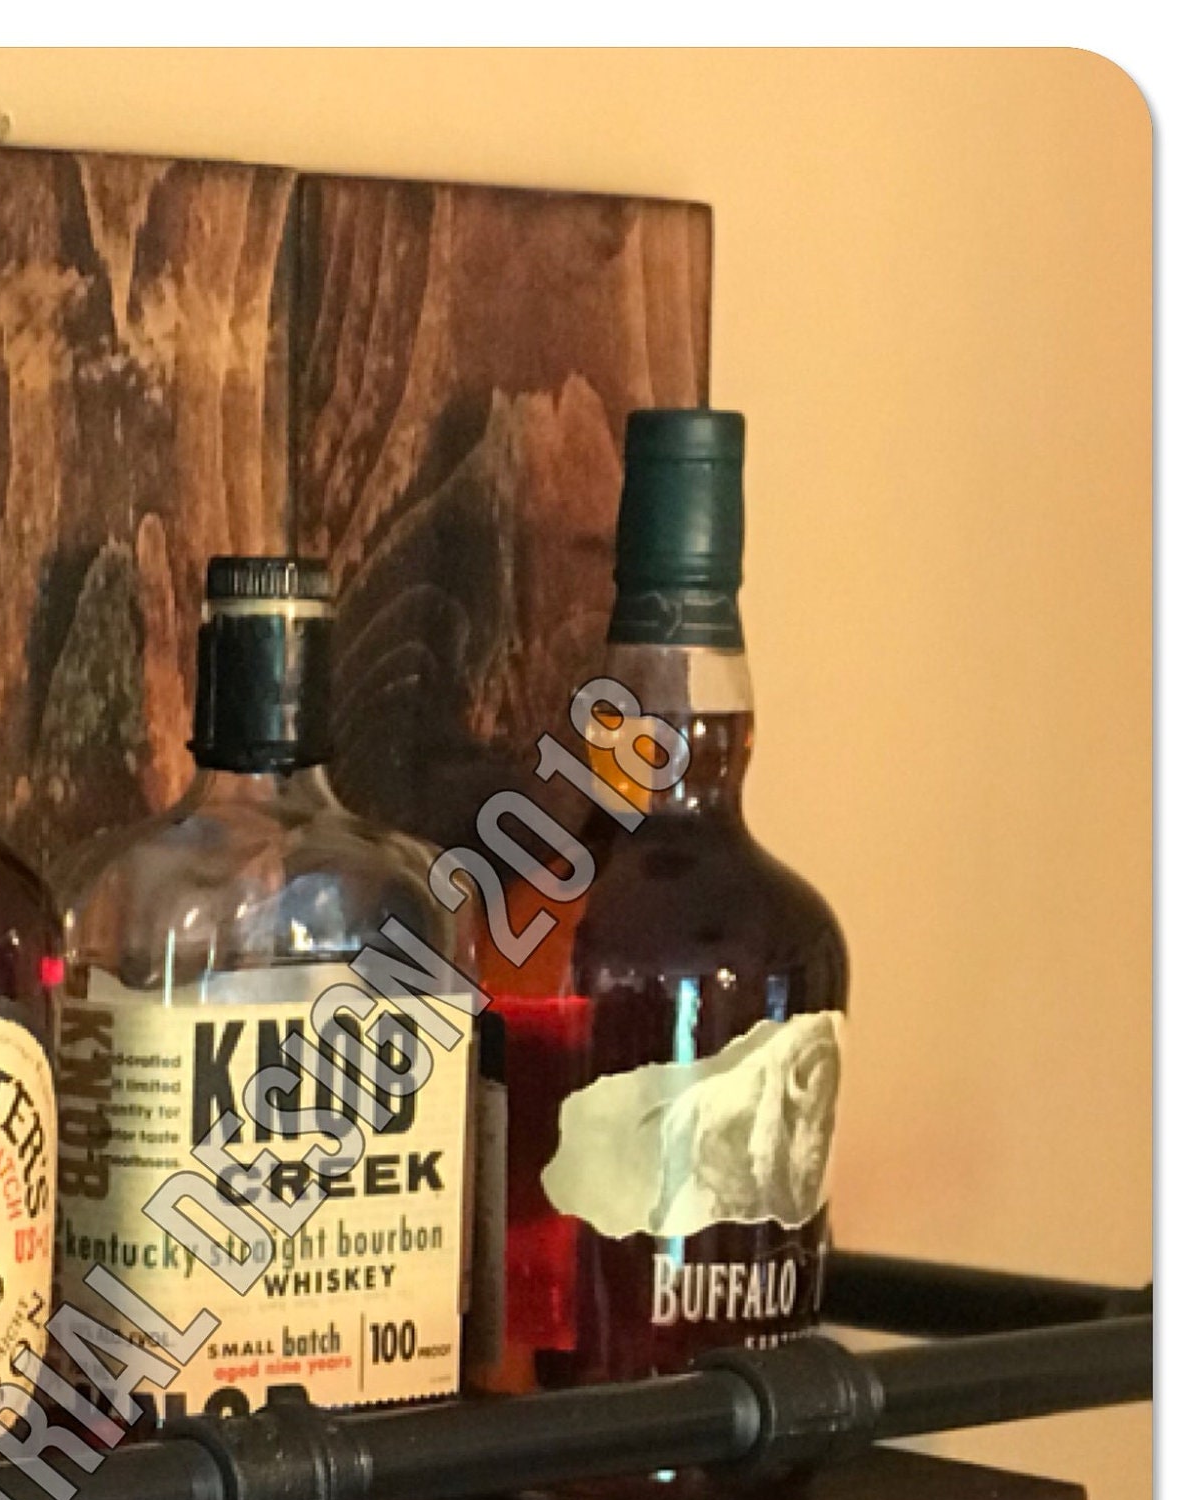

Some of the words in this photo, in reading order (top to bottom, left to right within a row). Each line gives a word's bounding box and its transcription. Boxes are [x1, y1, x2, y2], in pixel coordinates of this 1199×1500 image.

[190, 1013, 419, 1146] KNOB
[215, 1150, 445, 1206] CREEK
[64, 1217, 199, 1278] kentucky
[209, 1221, 325, 1269] straight
[337, 1214, 444, 1258] bourbon
[263, 1264, 397, 1298] WHISKEY
[207, 1341, 275, 1359] SMALL
[282, 1312, 341, 1357] batch
[369, 1319, 417, 1365] 100
[213, 1361, 260, 1382] aged
